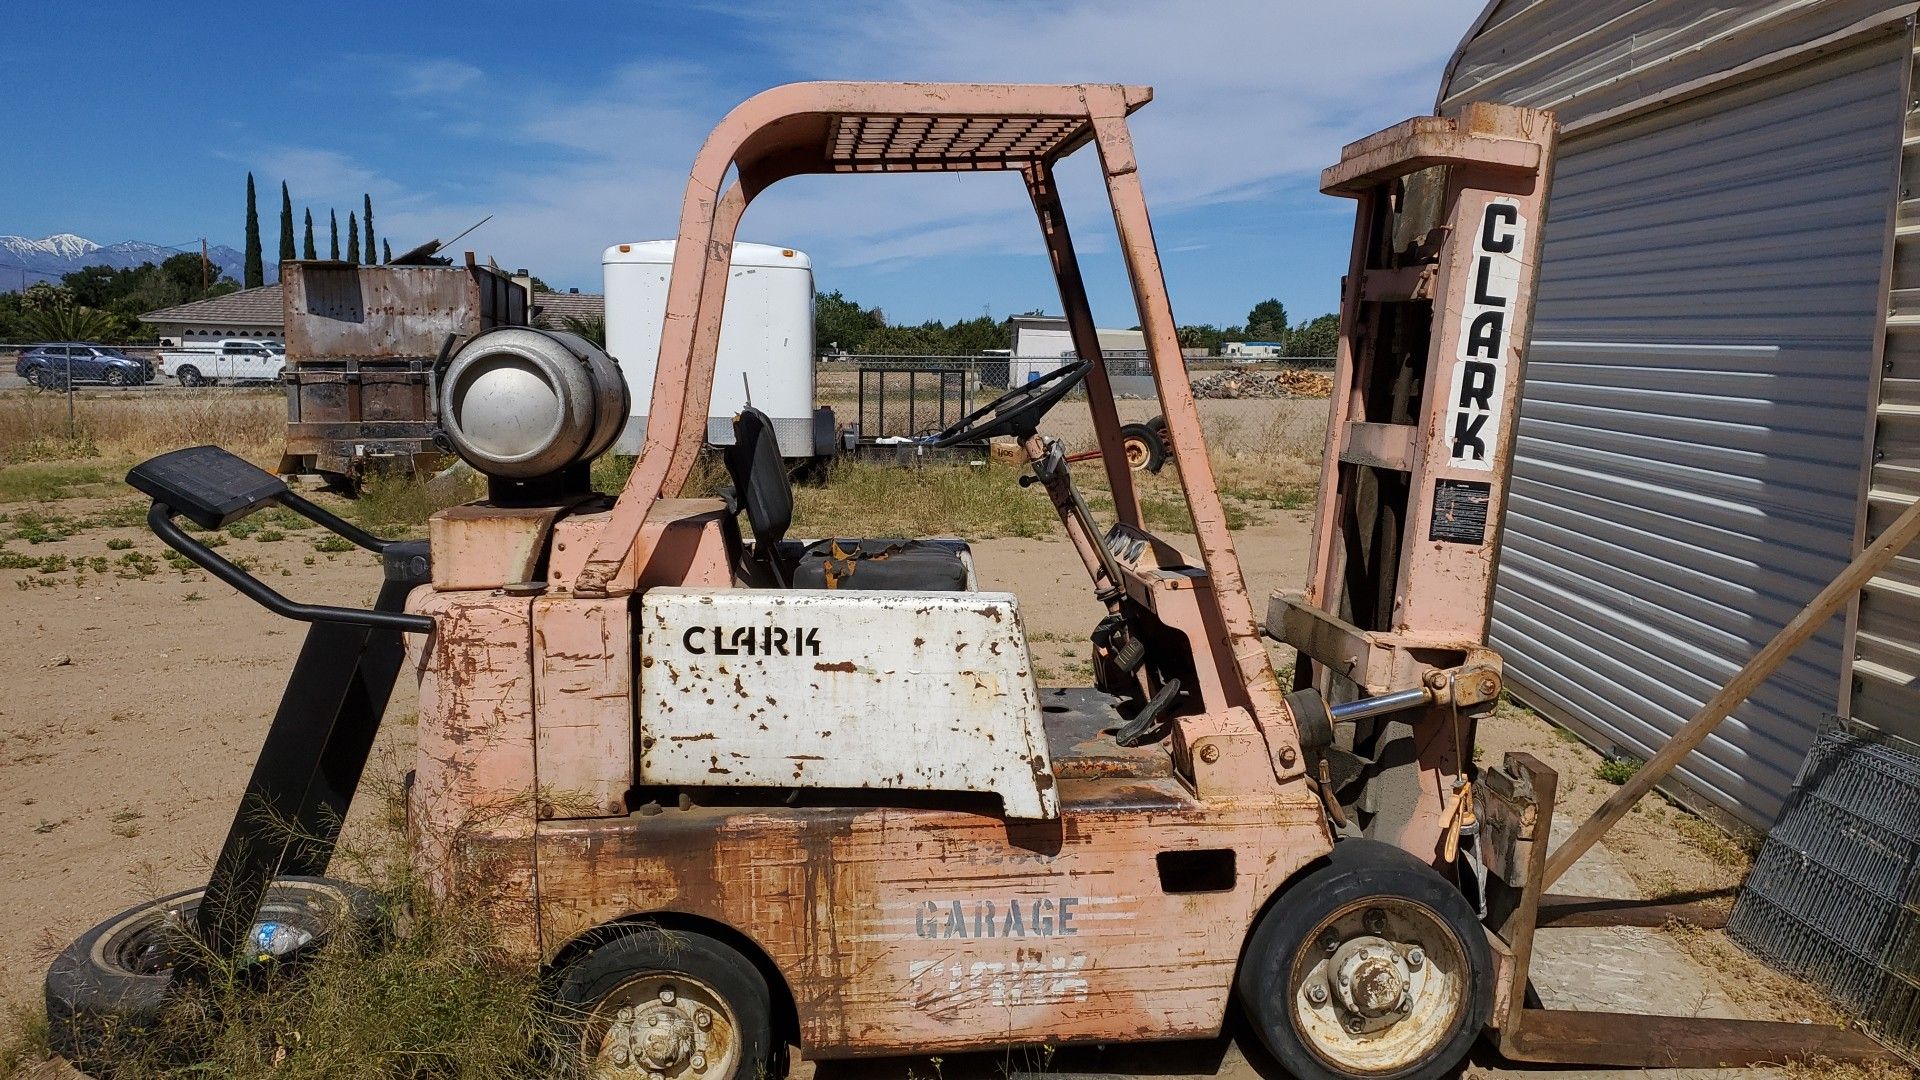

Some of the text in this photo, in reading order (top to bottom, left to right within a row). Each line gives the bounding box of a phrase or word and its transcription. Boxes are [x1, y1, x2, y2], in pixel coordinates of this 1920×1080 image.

[1452, 203, 1517, 460] CLARK
[683, 626, 820, 656] CLARK
[915, 897, 1079, 939] GARAGE
